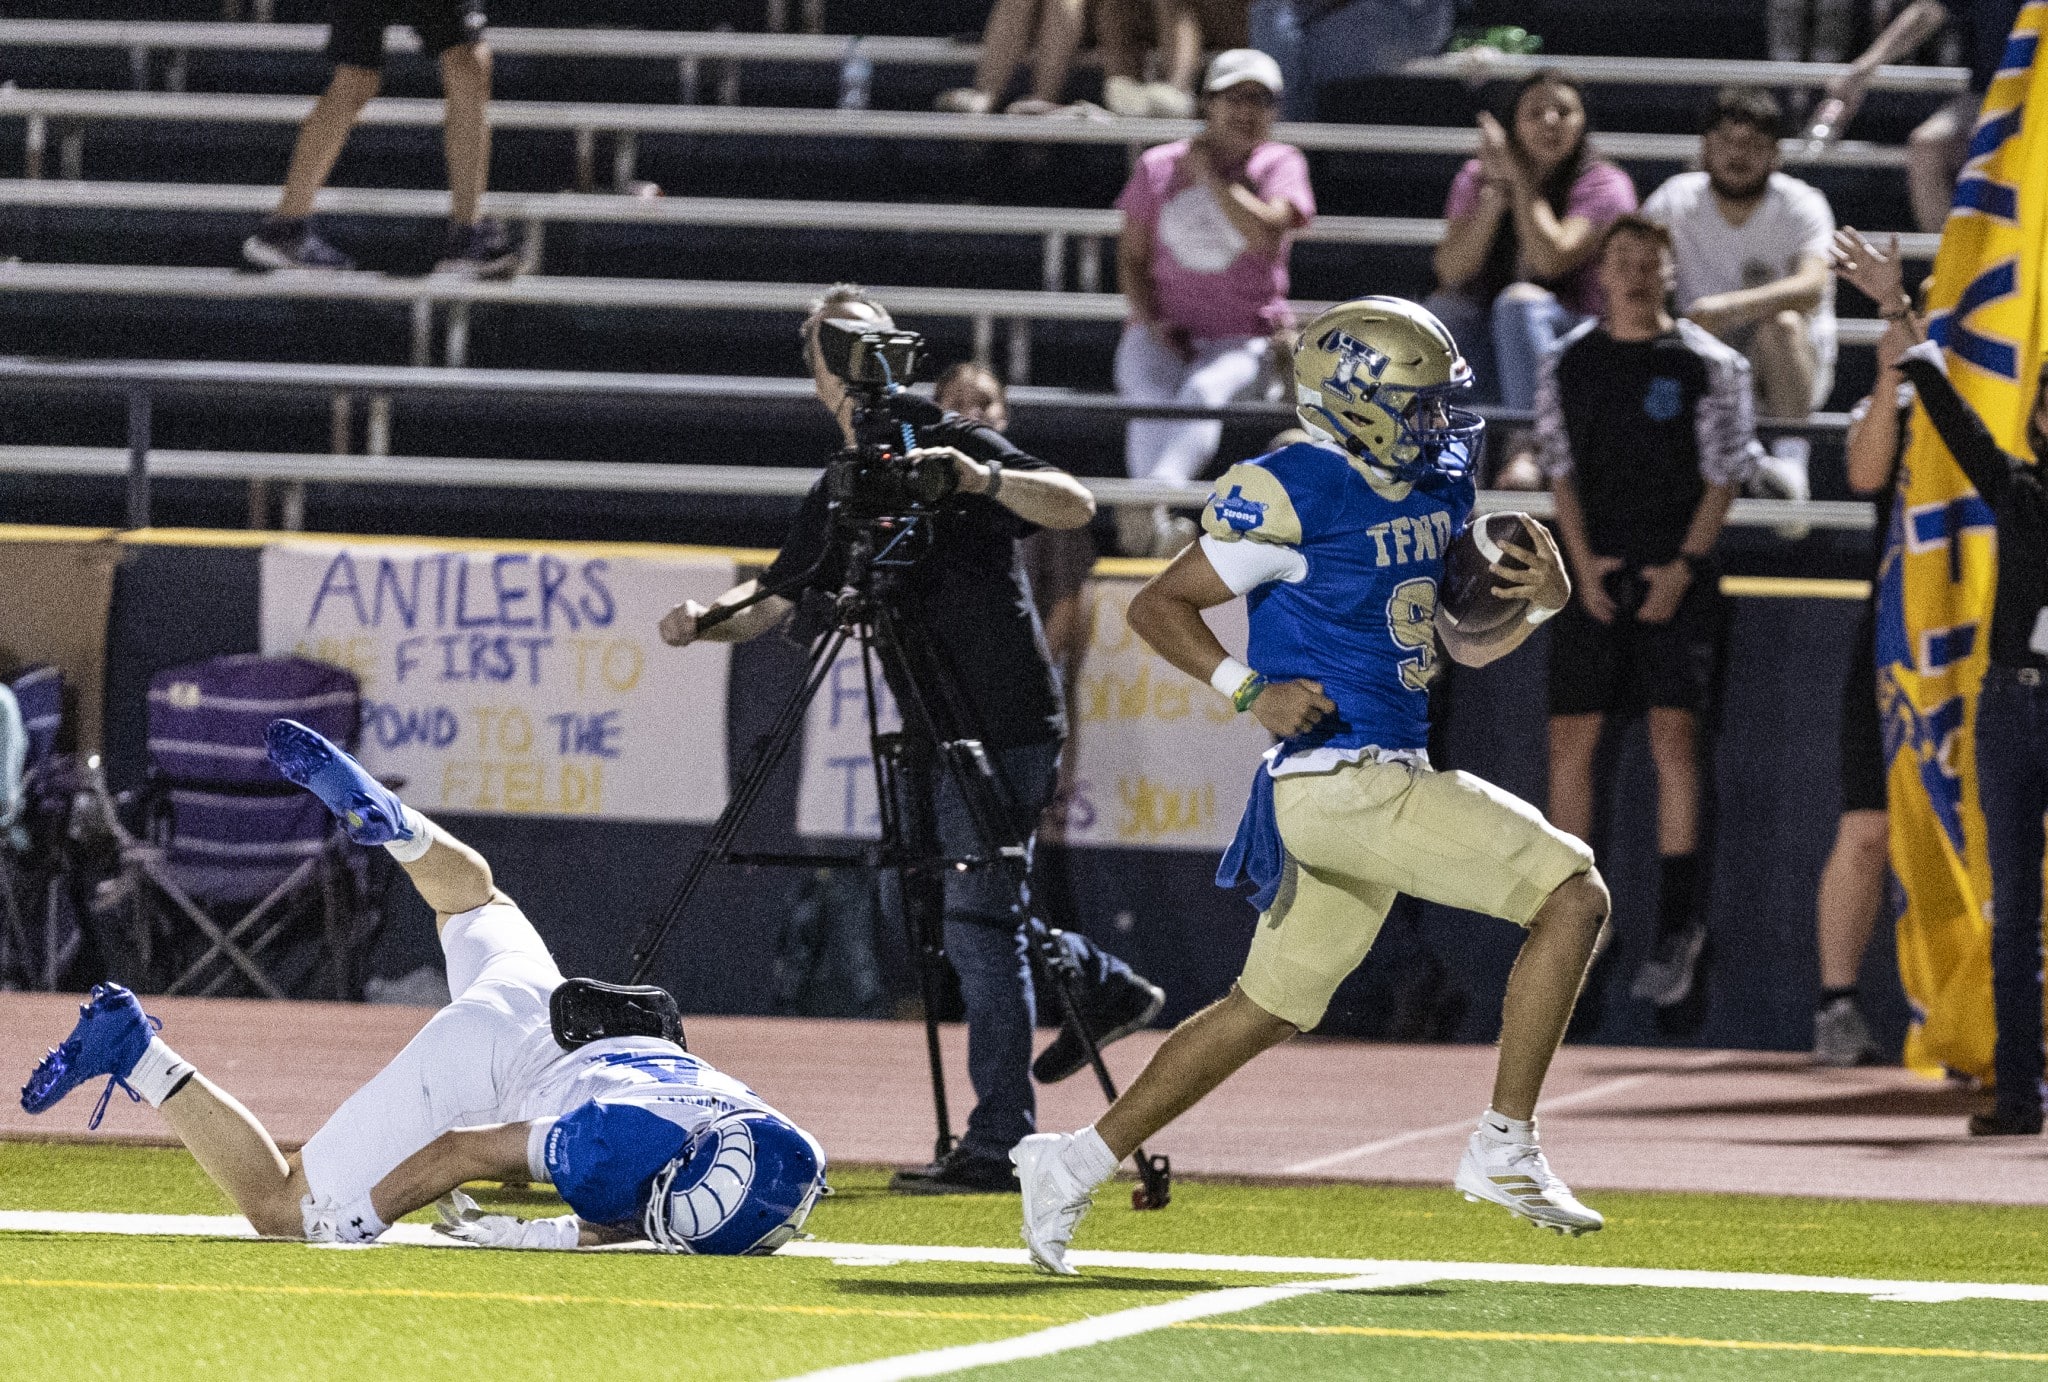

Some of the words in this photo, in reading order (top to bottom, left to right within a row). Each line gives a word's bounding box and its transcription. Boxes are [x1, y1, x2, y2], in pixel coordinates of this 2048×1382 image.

[1223, 508, 1257, 525] Strong
[306, 551, 615, 631] ANTLERS
[1386, 576, 1440, 692] 9
[395, 632, 553, 686] FIRST
[567, 636, 646, 694] TO
[473, 706, 534, 756] TO
[546, 709, 623, 759] THE
[441, 759, 608, 814] FIELD!
[549, 1127, 562, 1165] Strong
